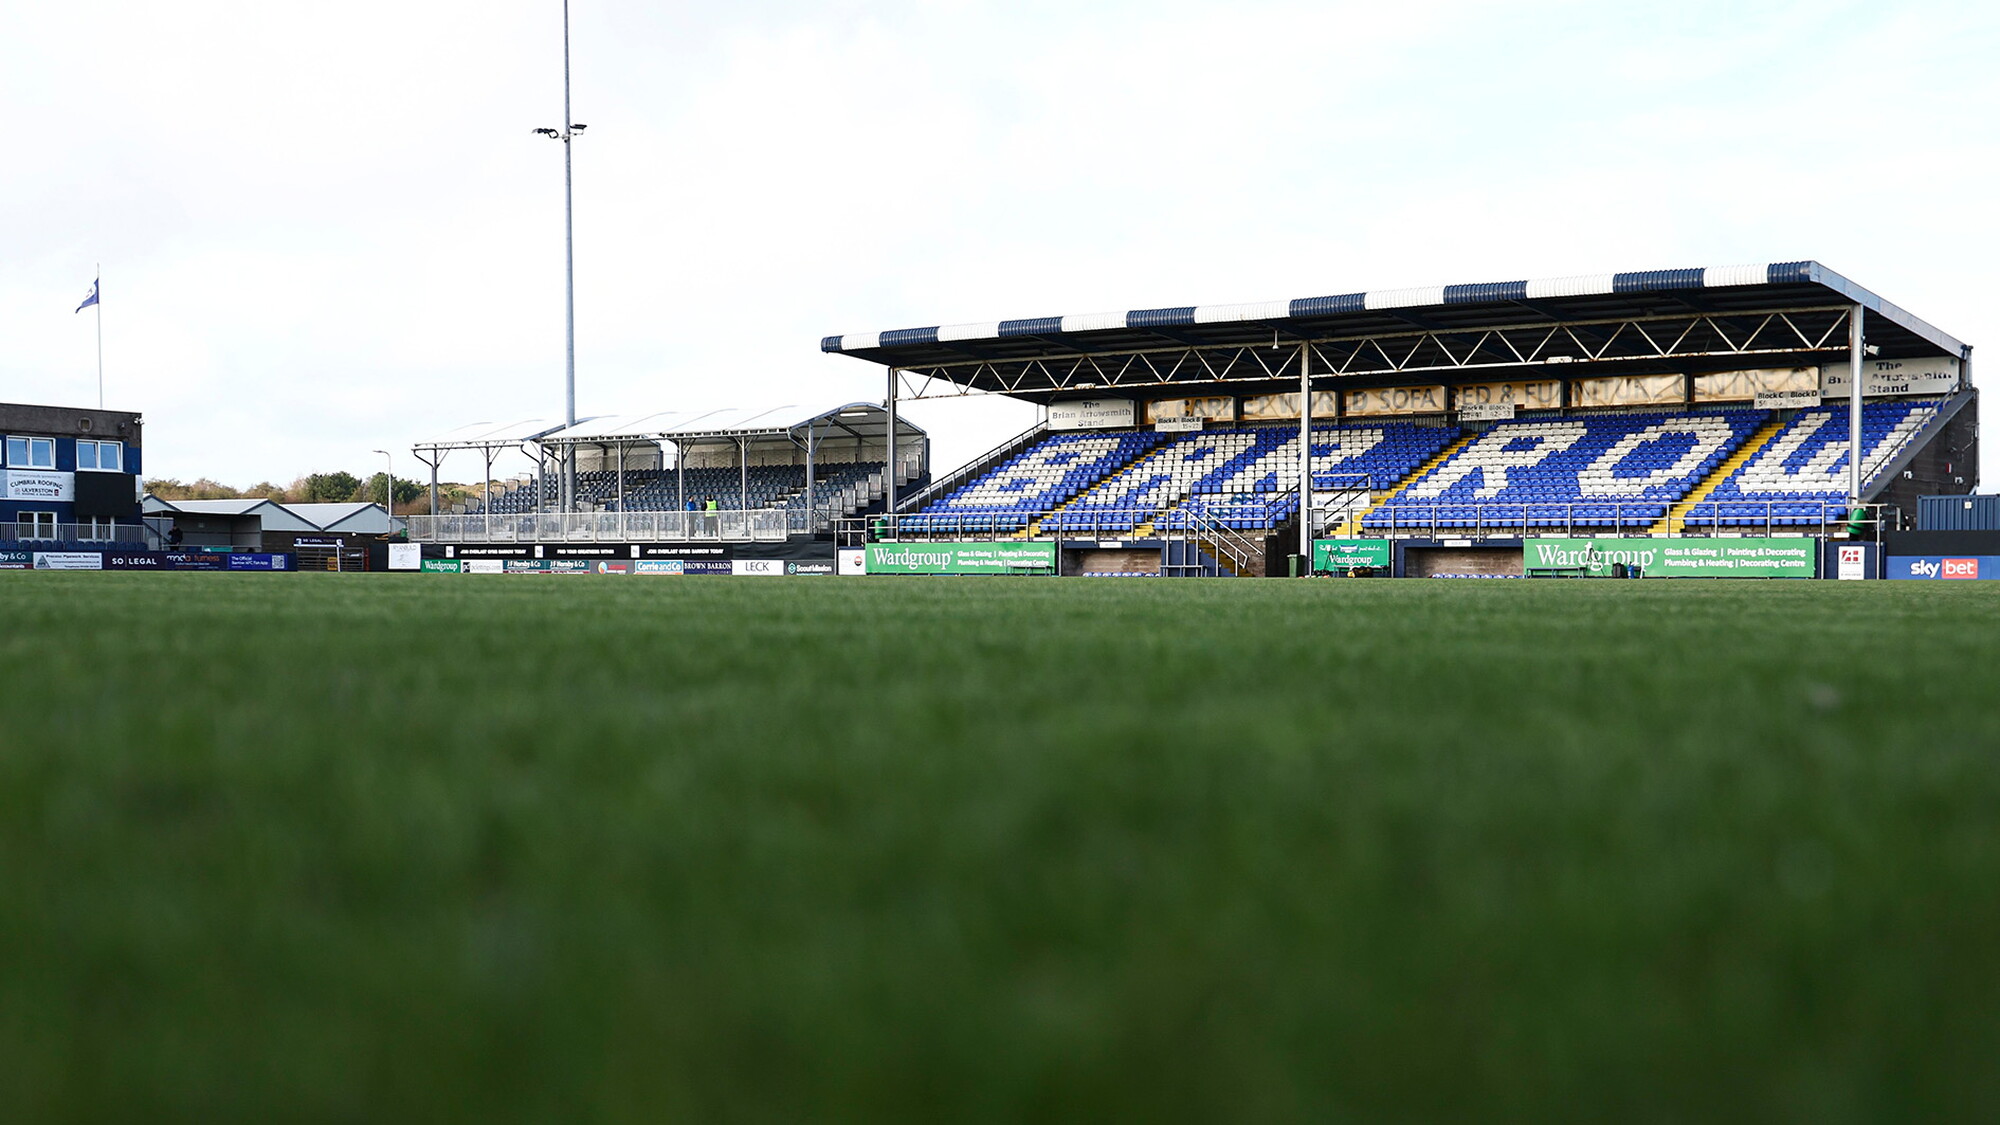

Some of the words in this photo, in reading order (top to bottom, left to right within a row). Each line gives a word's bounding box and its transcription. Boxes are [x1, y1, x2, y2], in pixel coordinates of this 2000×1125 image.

[1876, 362, 1902, 370] The
[1869, 384, 1909, 393] Stand
[1380, 388, 1438, 409] SOFA
[1080, 408, 1131, 418] Arrowsmith
[38, 480, 63, 489] ROOFING
[1536, 542, 1654, 572] Wardgroup
[1692, 548, 1717, 557] Glazing
[1727, 548, 1757, 557] Painting
[1766, 548, 1806, 557] Decorating
[874, 548, 950, 569] Wardgroup
[1330, 555, 1372, 566] Wardgroup
[425, 561, 458, 571] Wardgroup
[514, 561, 530, 569] Hornby
[557, 561, 574, 569] Hornby
[746, 562, 769, 571] LECK
[1664, 559, 1697, 568] Plumbing
[1705, 559, 1734, 568] Heating
[1740, 559, 1779, 568] Decorating
[1910, 560, 1940, 578] sky
[1945, 560, 1975, 574] bet
